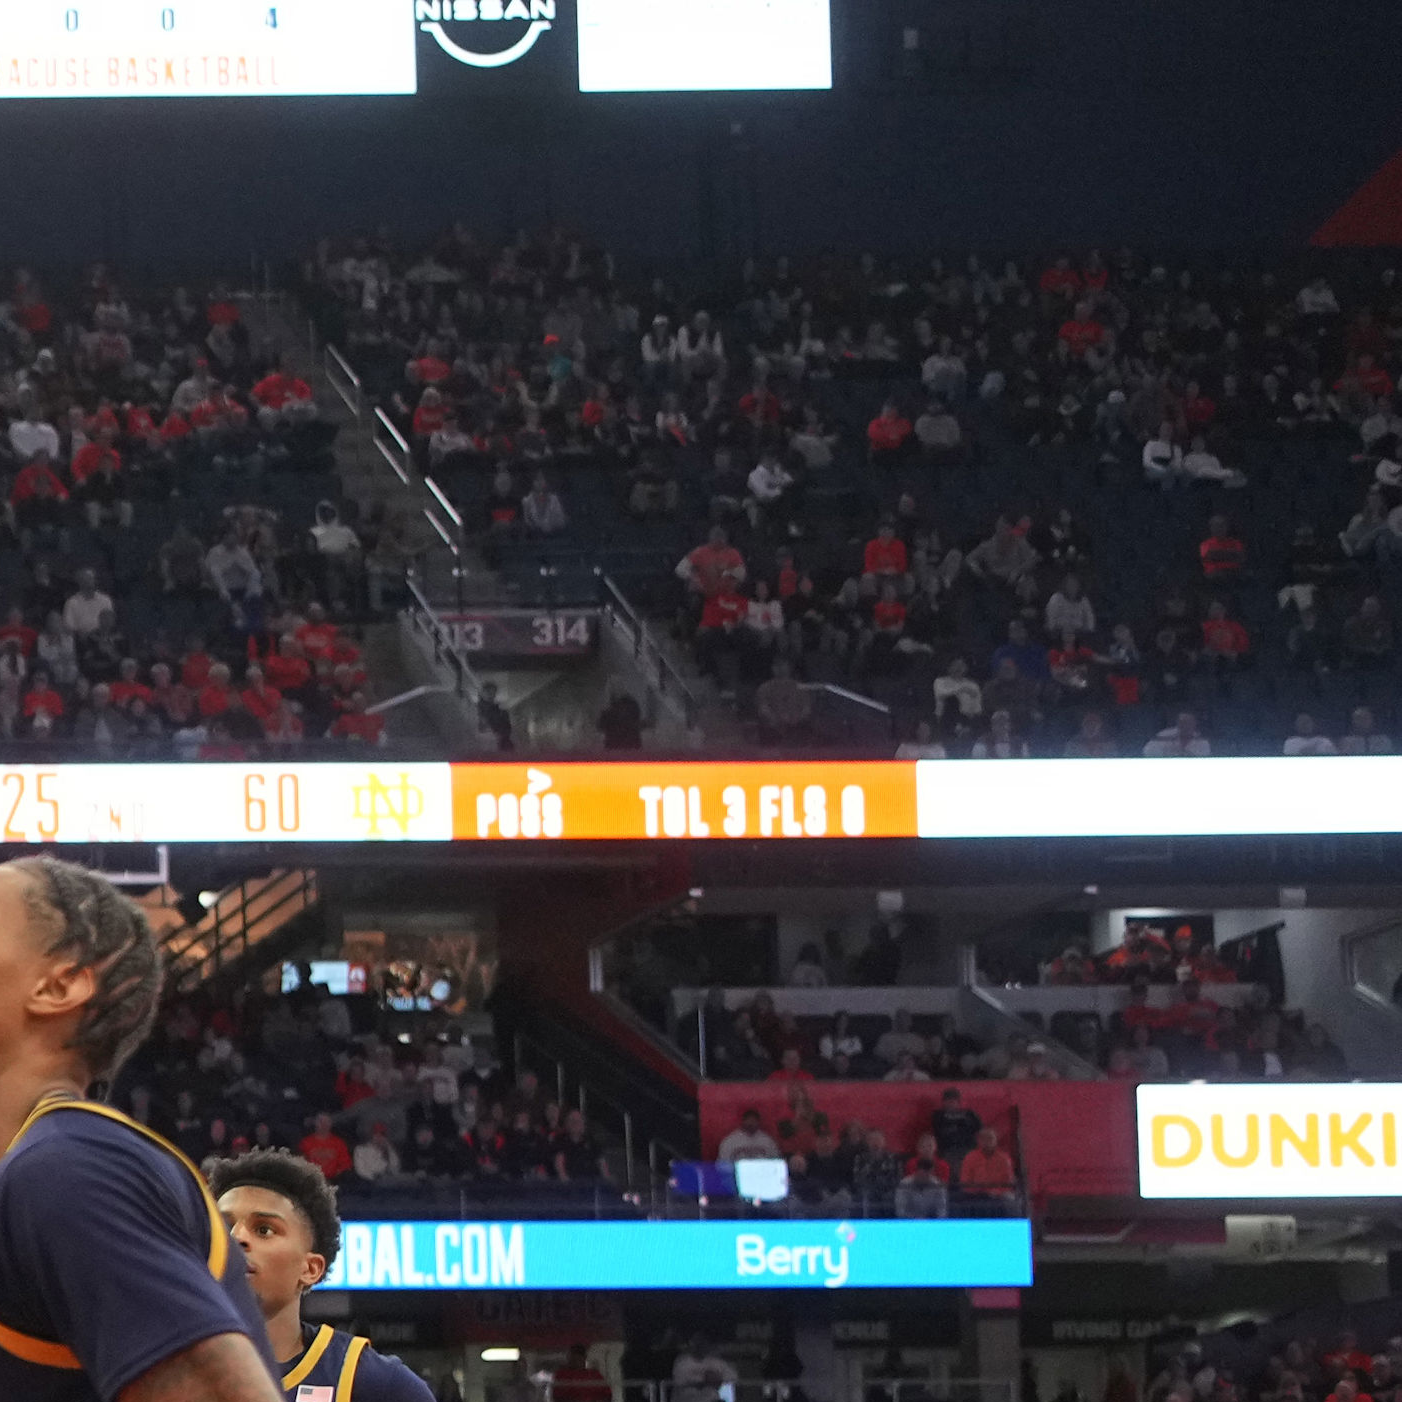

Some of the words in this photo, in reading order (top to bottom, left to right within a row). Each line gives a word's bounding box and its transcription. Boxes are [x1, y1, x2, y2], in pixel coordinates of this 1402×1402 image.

[64, 9, 79, 33] 0
[161, 8, 176, 32] 0
[264, 8, 279, 31] 4
[415, 0, 555, 20] NISSAN
[107, 55, 281, 88] BASKETBALL
[531, 616, 590, 648] 314
[243, 773, 299, 834] 60
[721, 786, 745, 838] 3
[734, 1232, 849, 1288] Berry
